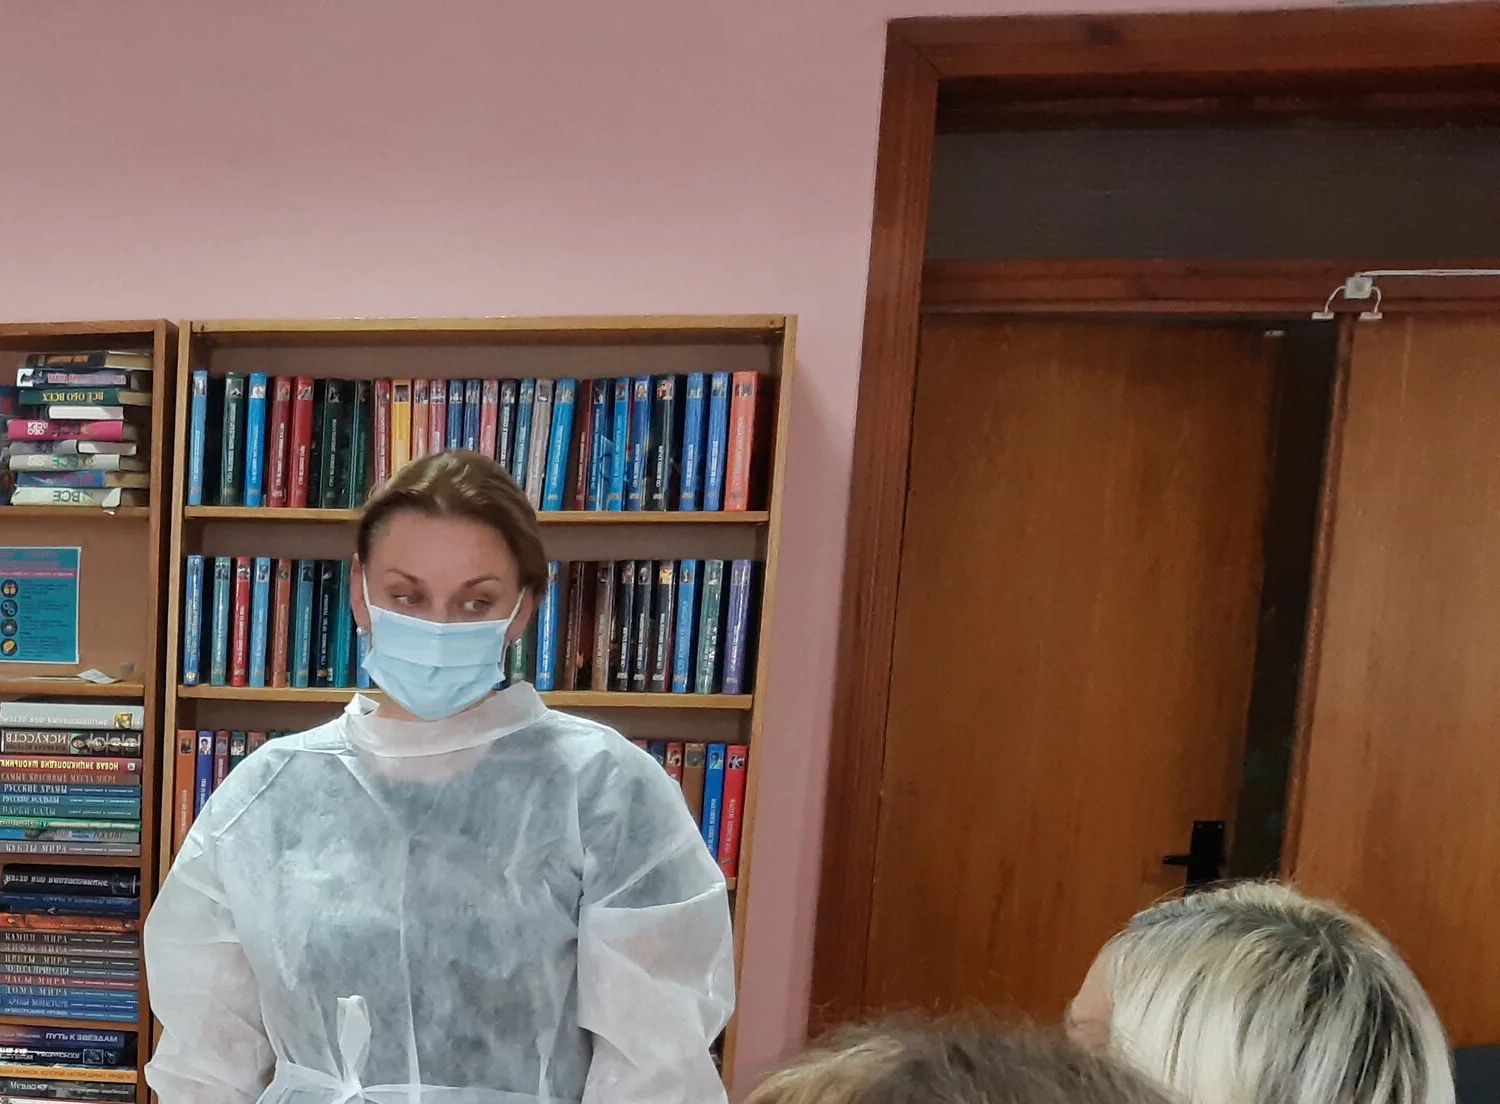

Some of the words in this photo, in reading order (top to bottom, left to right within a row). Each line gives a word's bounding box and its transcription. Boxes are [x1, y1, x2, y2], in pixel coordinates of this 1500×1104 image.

[53, 490, 80, 502] ВСЕ
[6, 732, 67, 744] ИСКУССТВ
[96, 763, 119, 771] НОВАЯ
[4, 784, 37, 793] РУССКИЕ
[5, 843, 37, 853] КУКЛЫ
[41, 844, 67, 853] МИРА
[44, 934, 68, 943] МИРА
[44, 955, 67, 965] МИРА
[5, 974, 32, 984] ЧАСЫ
[38, 976, 66, 985] МИРА
[40, 987, 68, 997] МИРА
[45, 1033, 68, 1041] ПУТЬ
